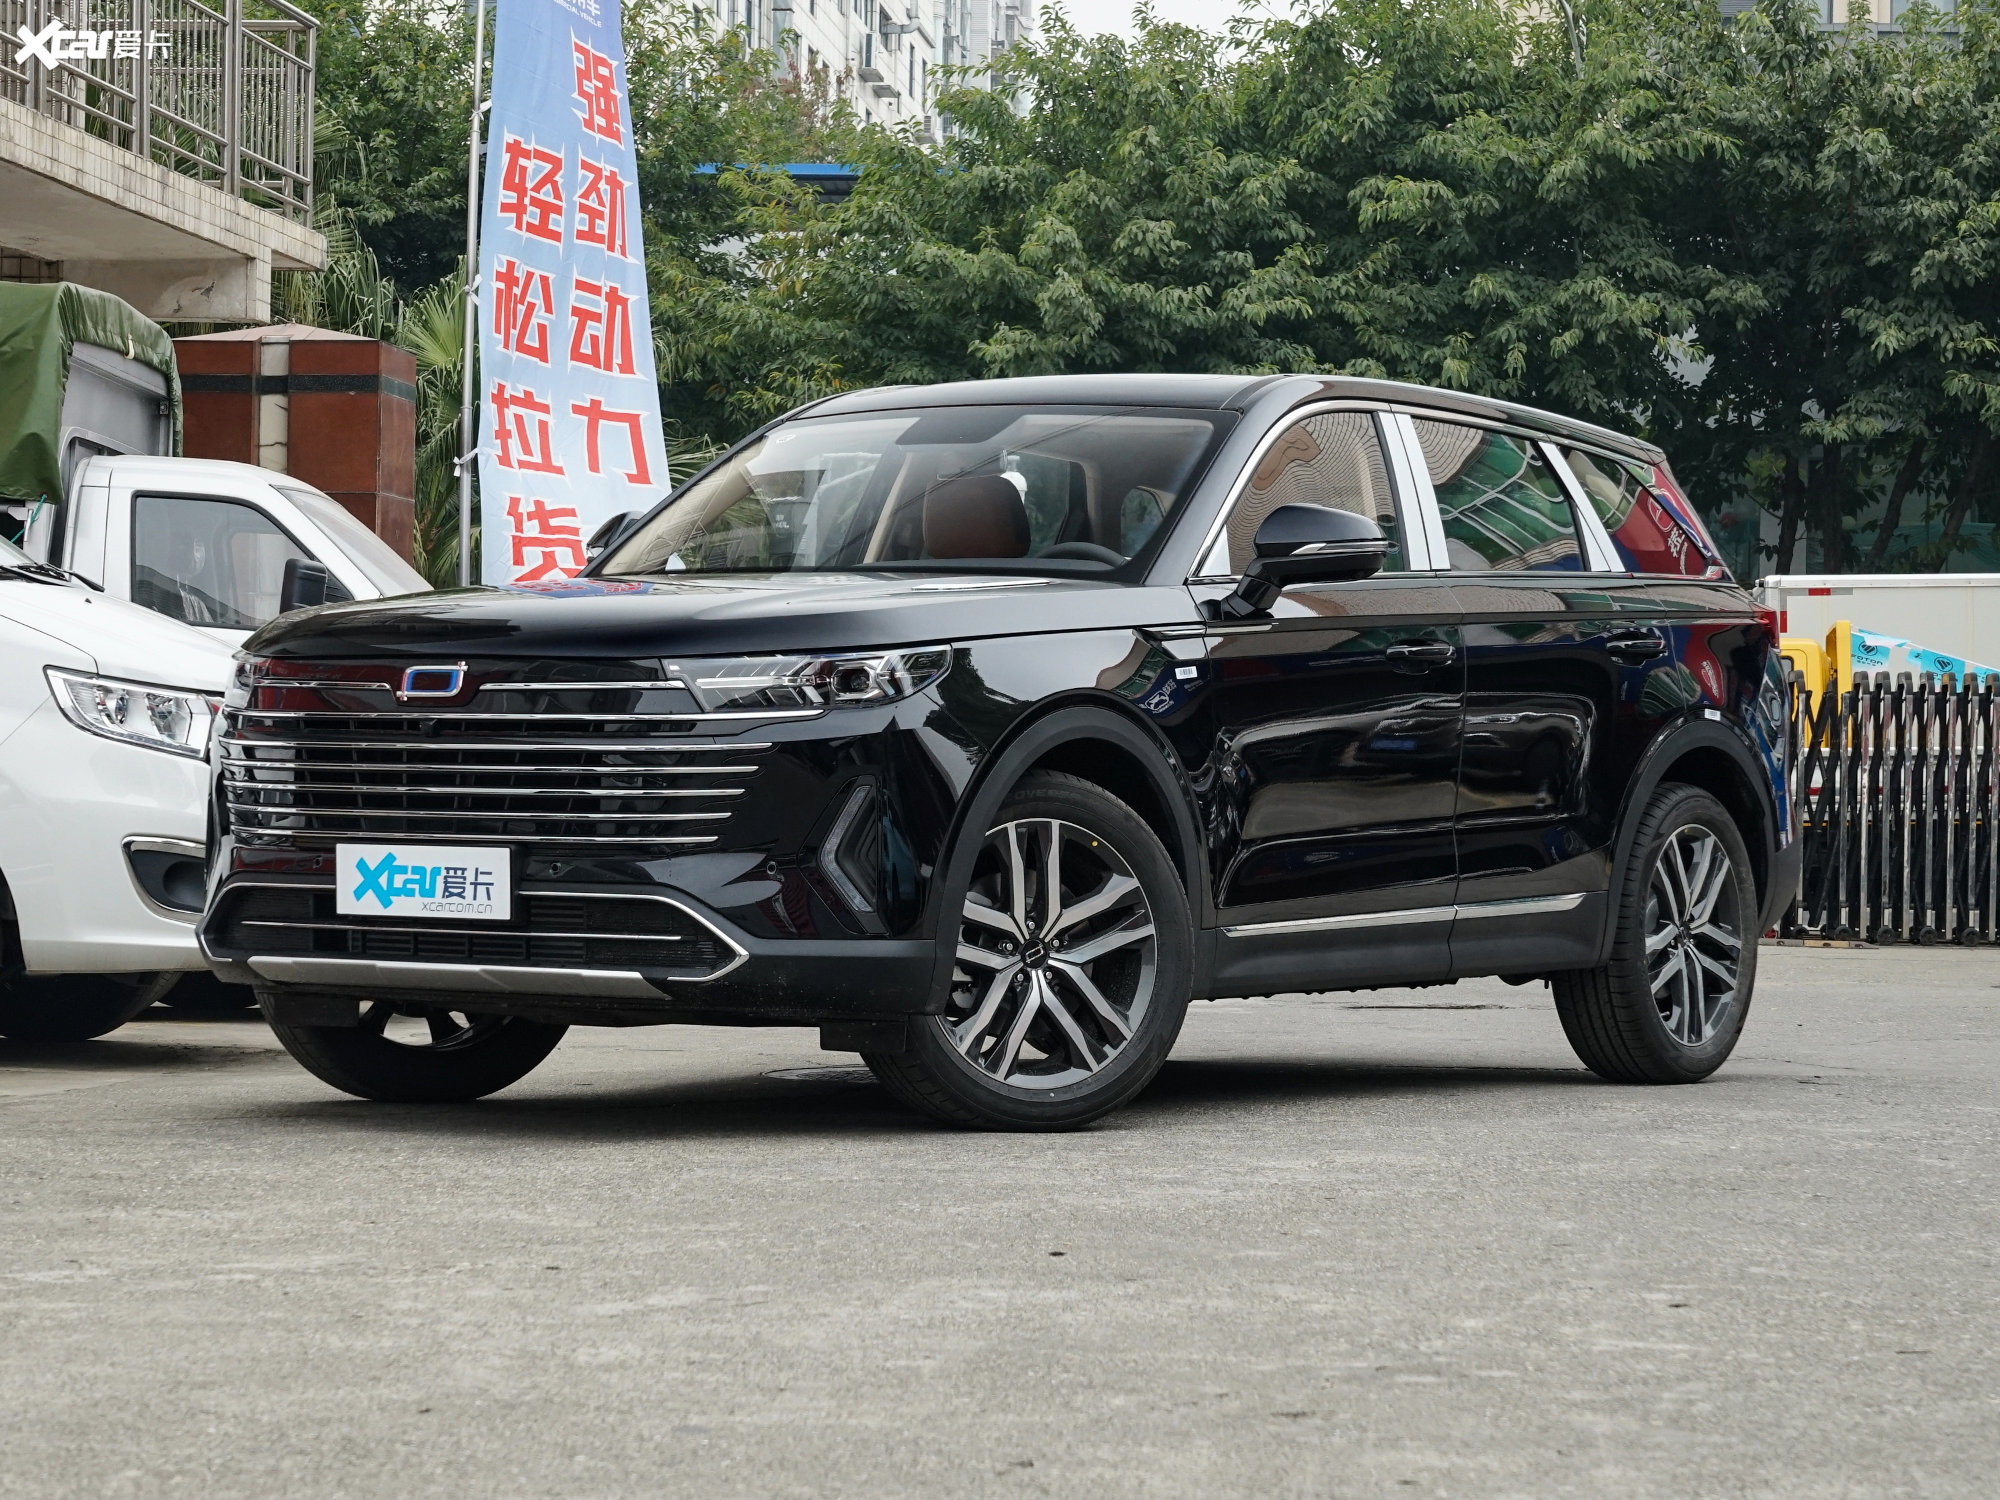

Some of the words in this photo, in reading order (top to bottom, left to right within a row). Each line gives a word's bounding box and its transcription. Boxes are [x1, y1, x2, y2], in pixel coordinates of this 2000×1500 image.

[490, 137, 588, 582] 轻松拉货
[570, 38, 654, 485] 强劲动力
